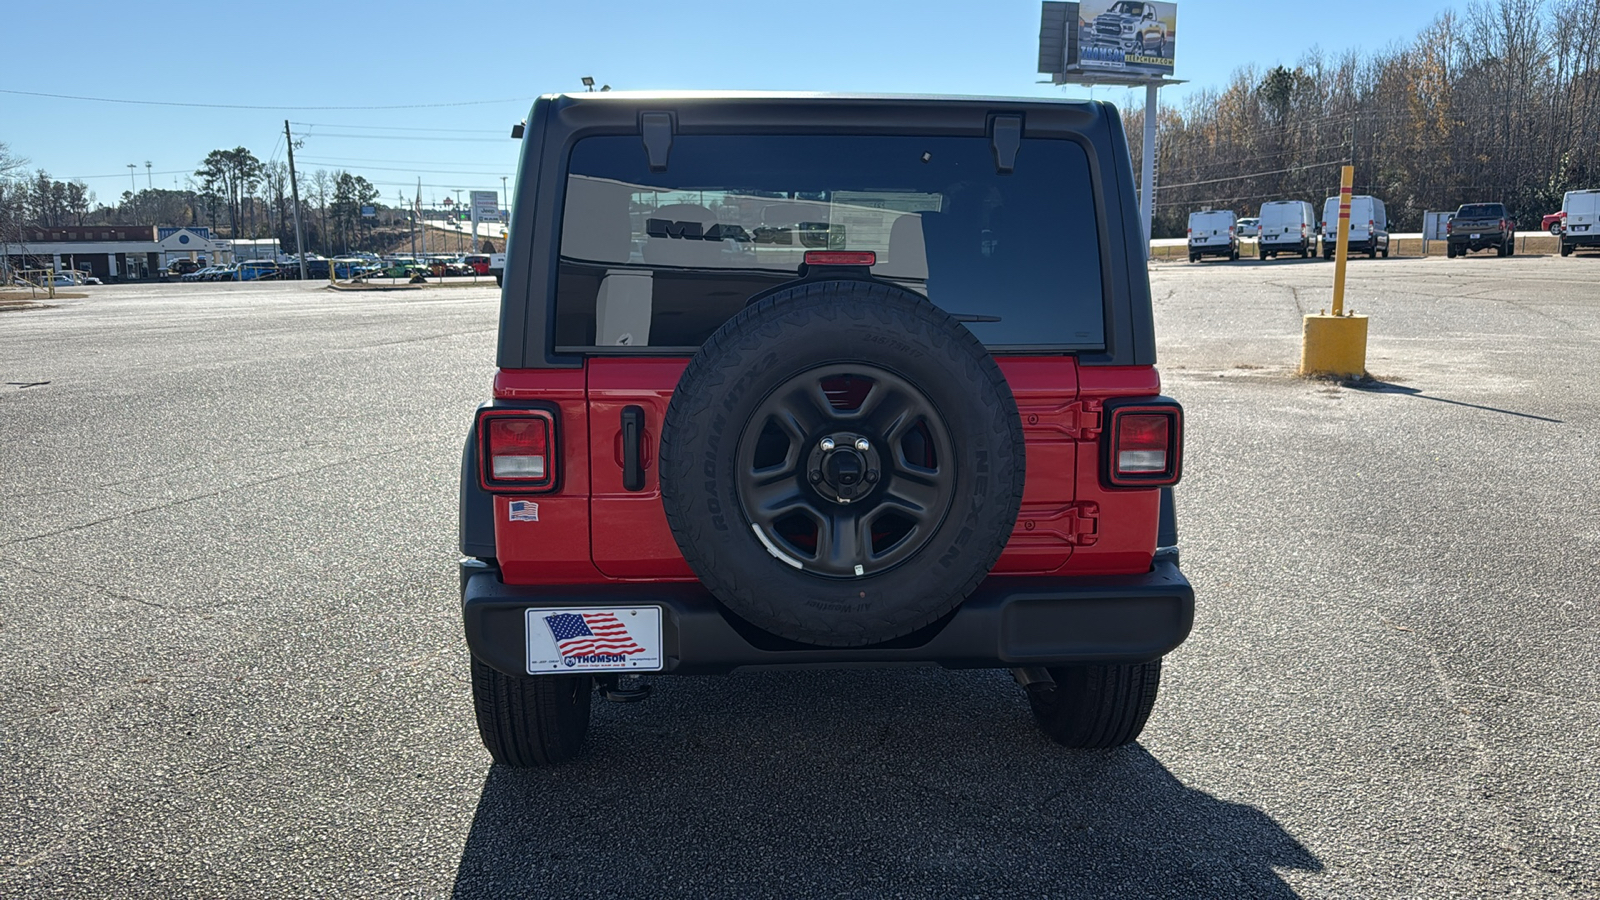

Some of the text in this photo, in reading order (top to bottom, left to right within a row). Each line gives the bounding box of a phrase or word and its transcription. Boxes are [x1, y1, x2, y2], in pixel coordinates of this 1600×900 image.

[1081, 47, 1126, 62] THOMSON
[1126, 55, 1173, 65] JEEPCHEAP.COM
[703, 413, 729, 532] ROADIAN
[938, 450, 989, 569] NEXEN
[803, 600, 872, 613] All-Weather
[577, 654, 626, 664] THOMSON
